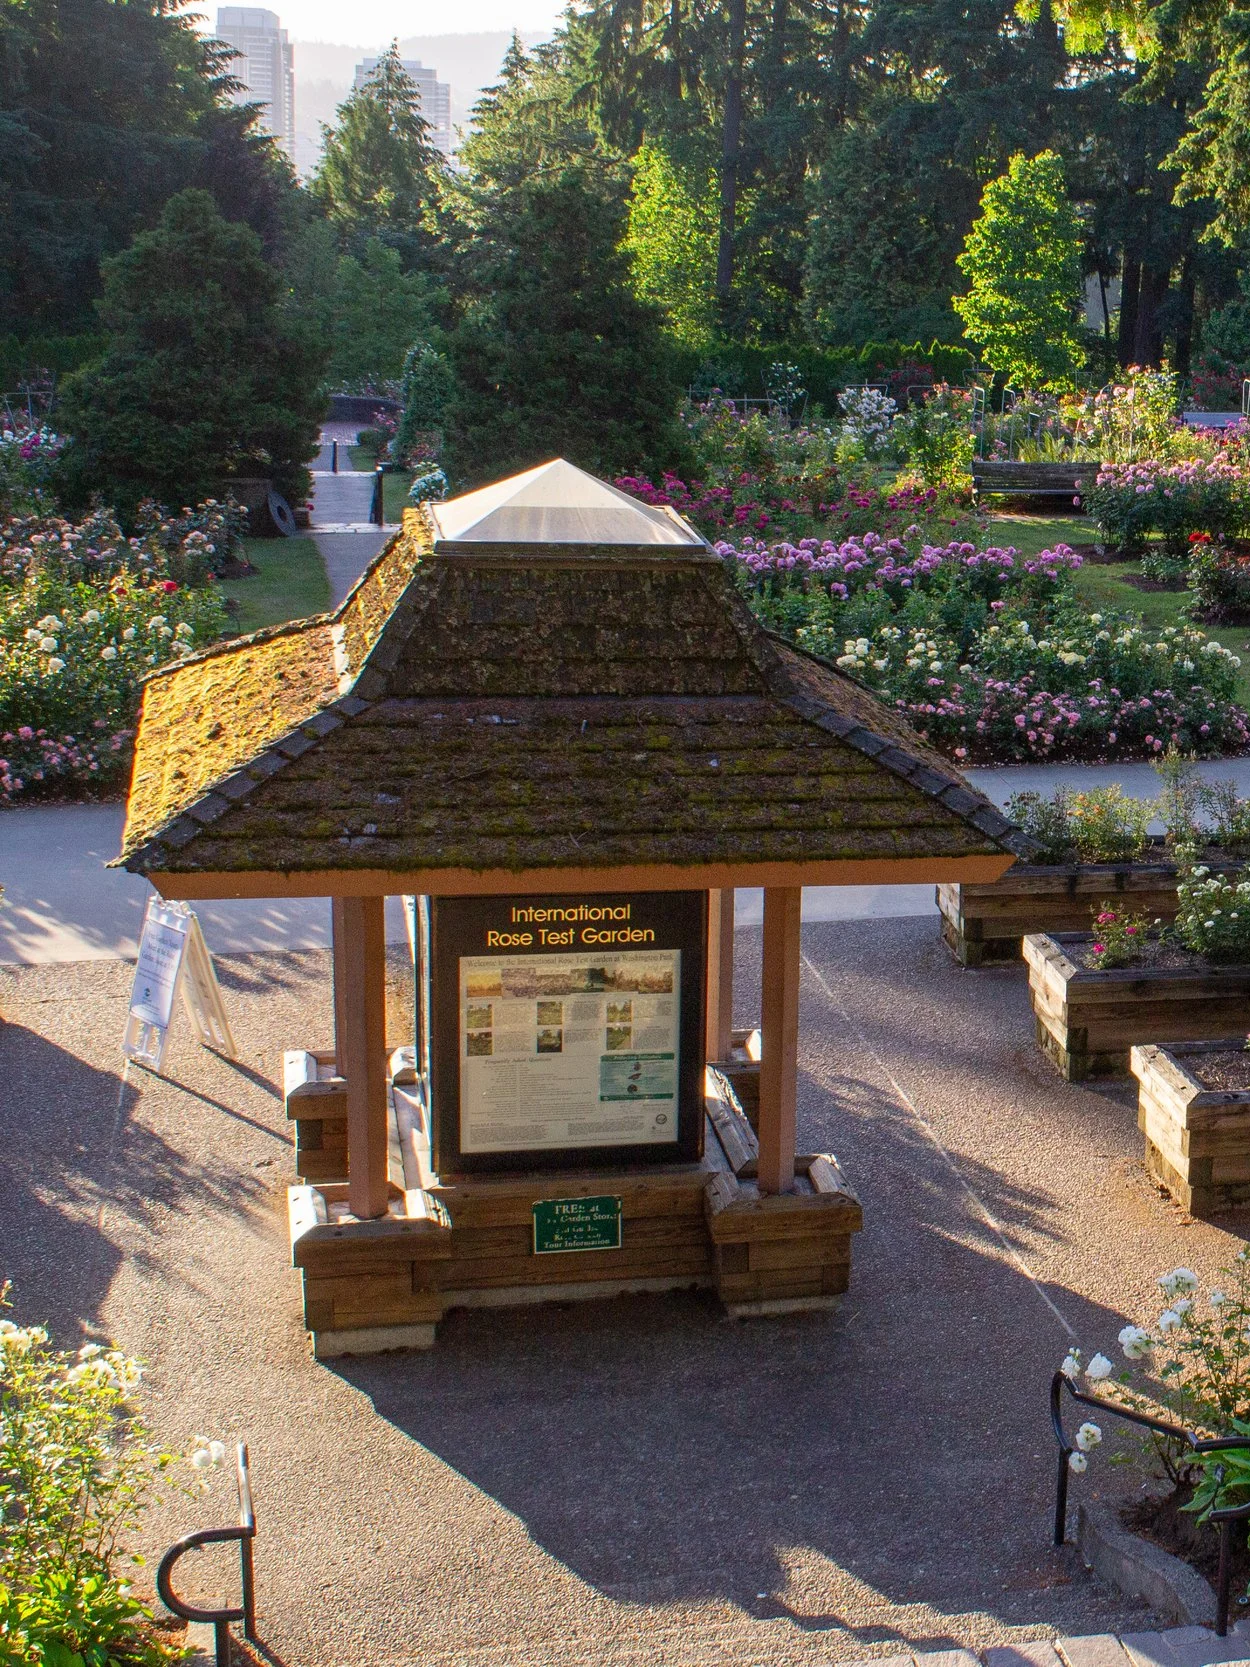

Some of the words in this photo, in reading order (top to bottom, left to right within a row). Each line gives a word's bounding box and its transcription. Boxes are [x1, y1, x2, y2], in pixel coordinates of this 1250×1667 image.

[512, 904, 631, 921] International
[486, 930, 533, 947] Rose
[538, 927, 575, 944] Test
[580, 926, 656, 944] Garden
